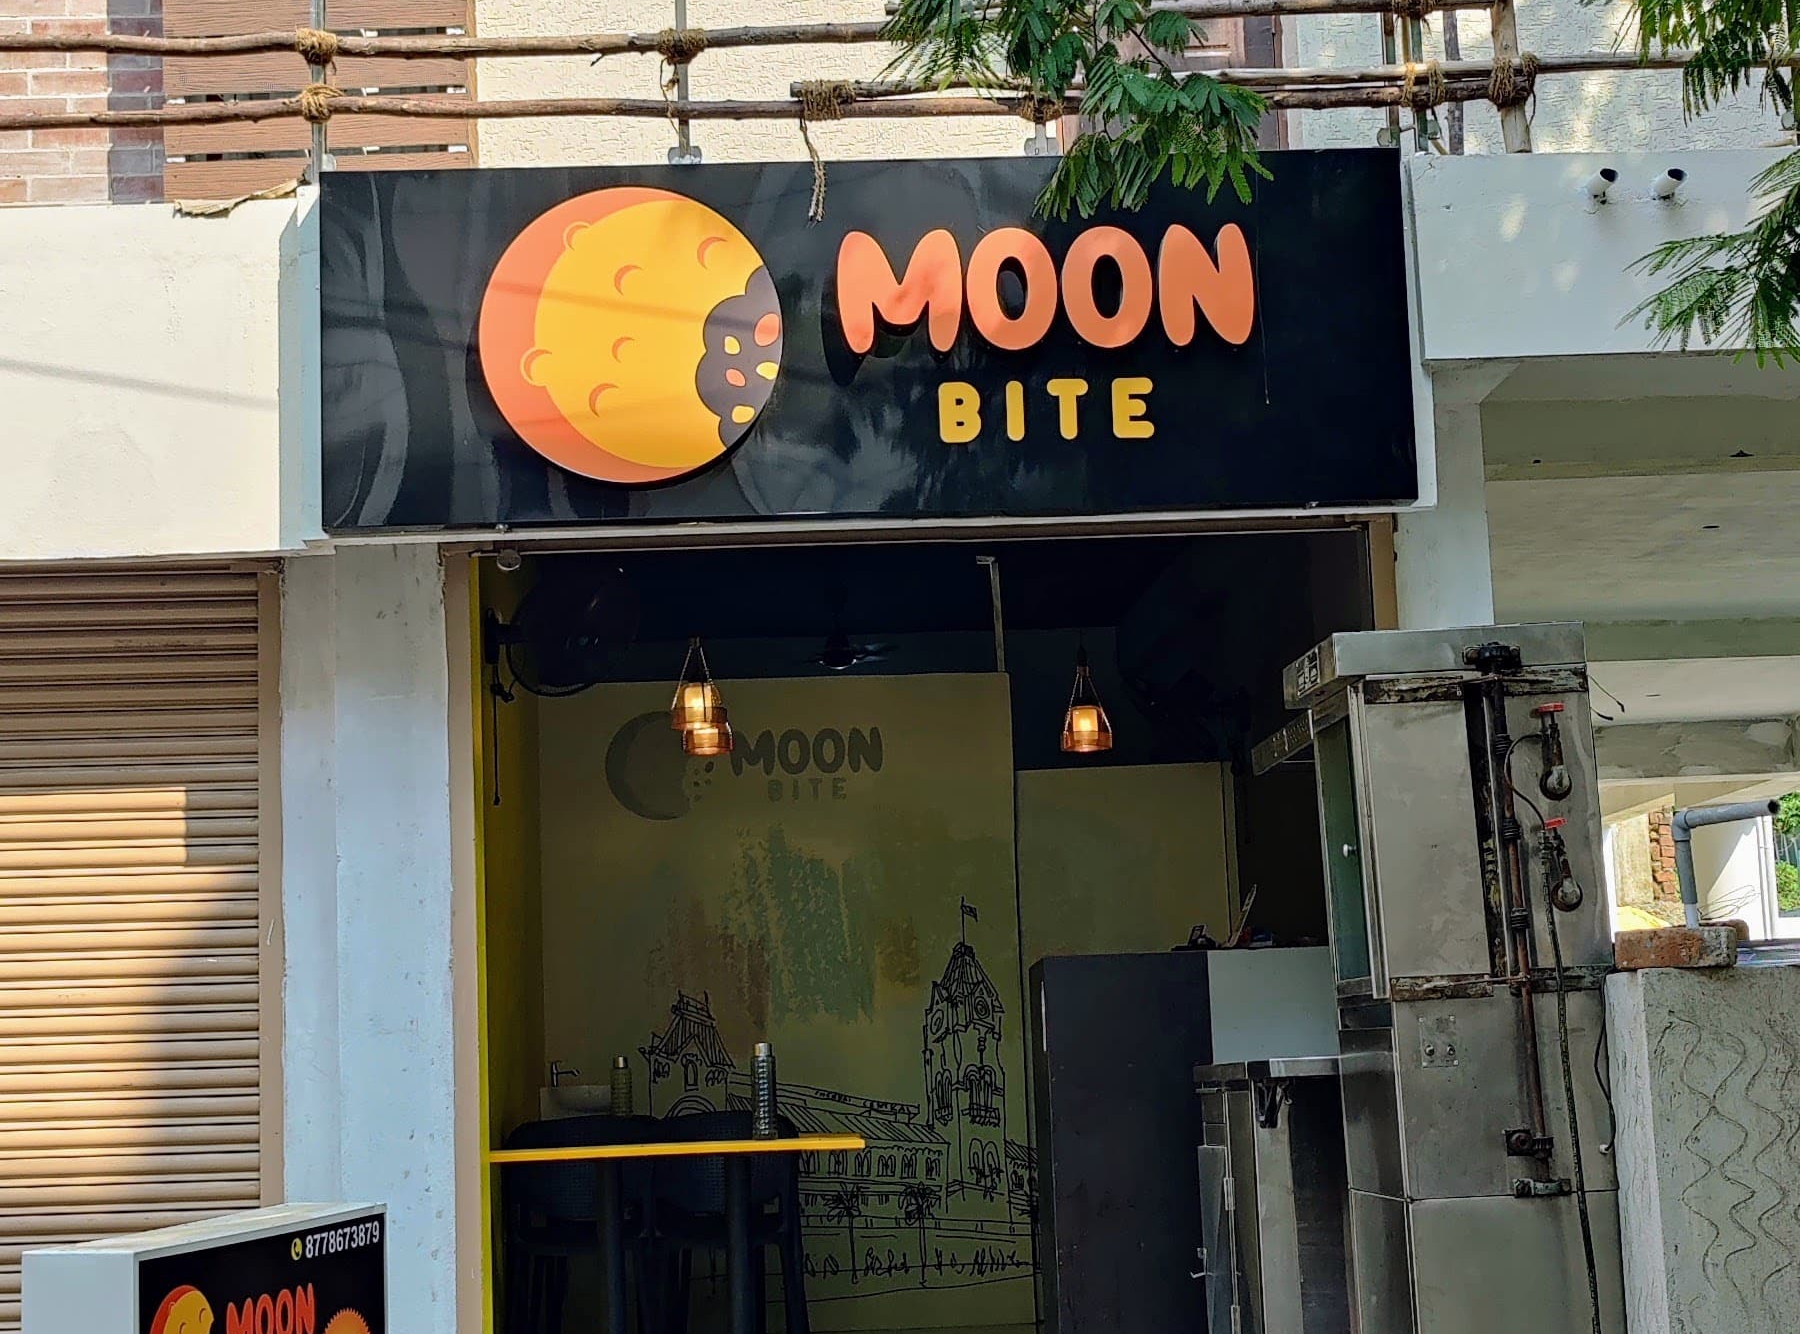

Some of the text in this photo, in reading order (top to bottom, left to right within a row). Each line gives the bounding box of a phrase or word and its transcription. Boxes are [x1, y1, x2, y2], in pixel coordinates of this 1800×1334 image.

[837, 223, 1254, 355] MOON
[937, 376, 1155, 444] BITE
[731, 726, 883, 777] MOON
[767, 776, 848, 802] BITE
[305, 1220, 380, 1258] 8778673879
